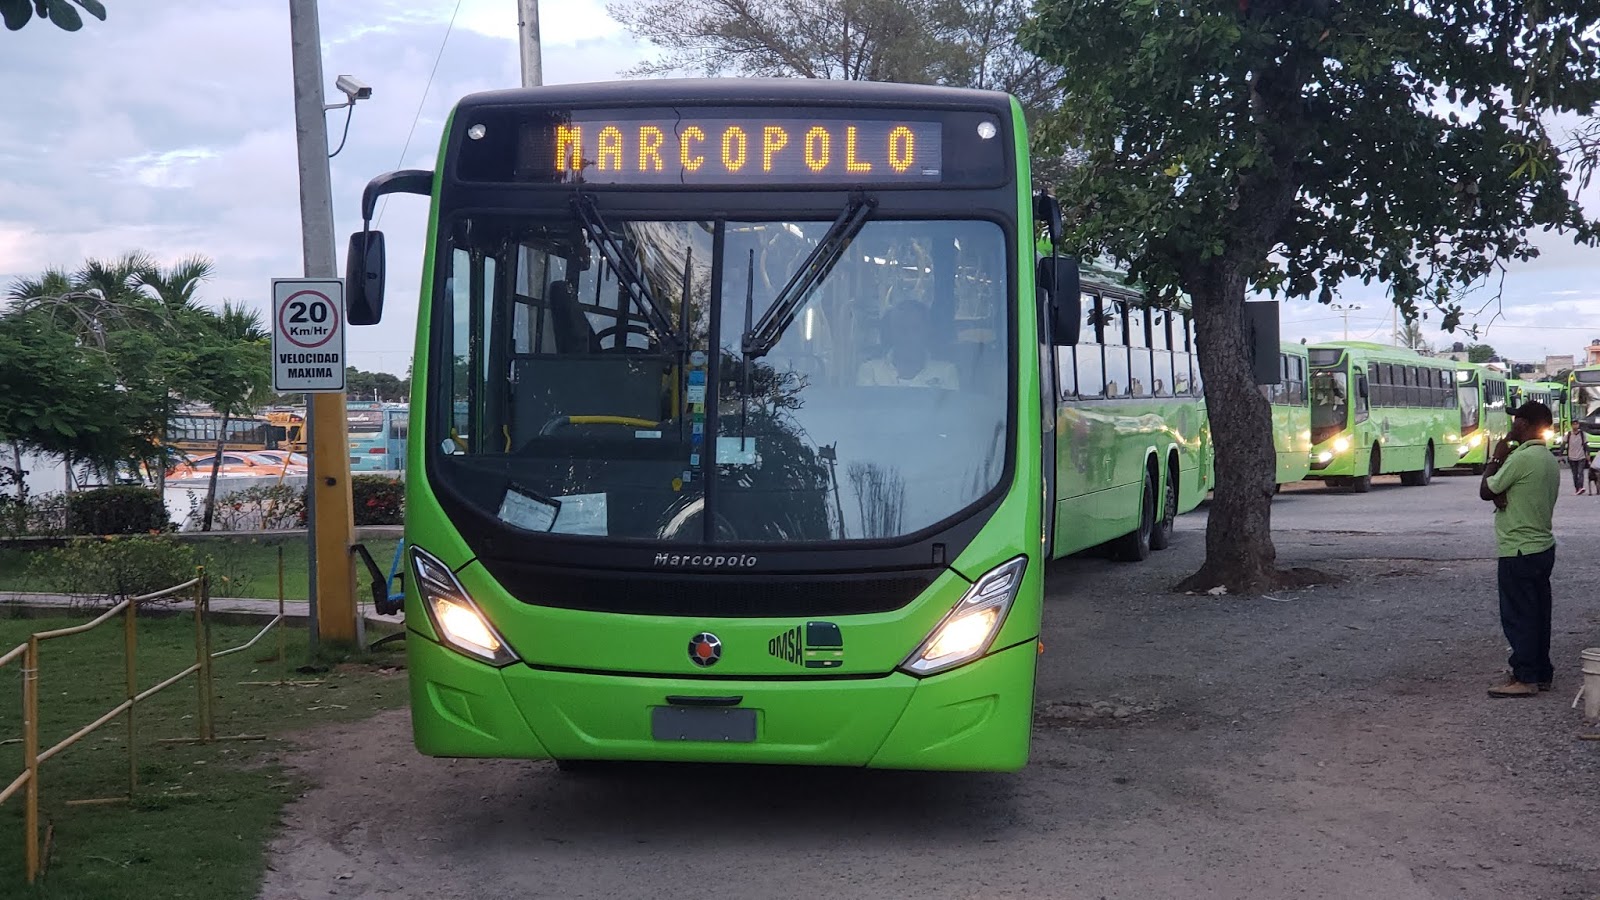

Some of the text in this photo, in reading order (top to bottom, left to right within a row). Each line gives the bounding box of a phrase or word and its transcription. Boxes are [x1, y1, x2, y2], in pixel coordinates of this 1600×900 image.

[556, 125, 914, 172] MARCOPOLO
[289, 301, 327, 323] 20
[290, 326, 328, 336] Km/Hr
[280, 353, 339, 364] VELOCIDAD
[288, 367, 333, 378] MAXIMA
[654, 553, 757, 568] Marcopolo
[768, 624, 803, 667] OMSA
